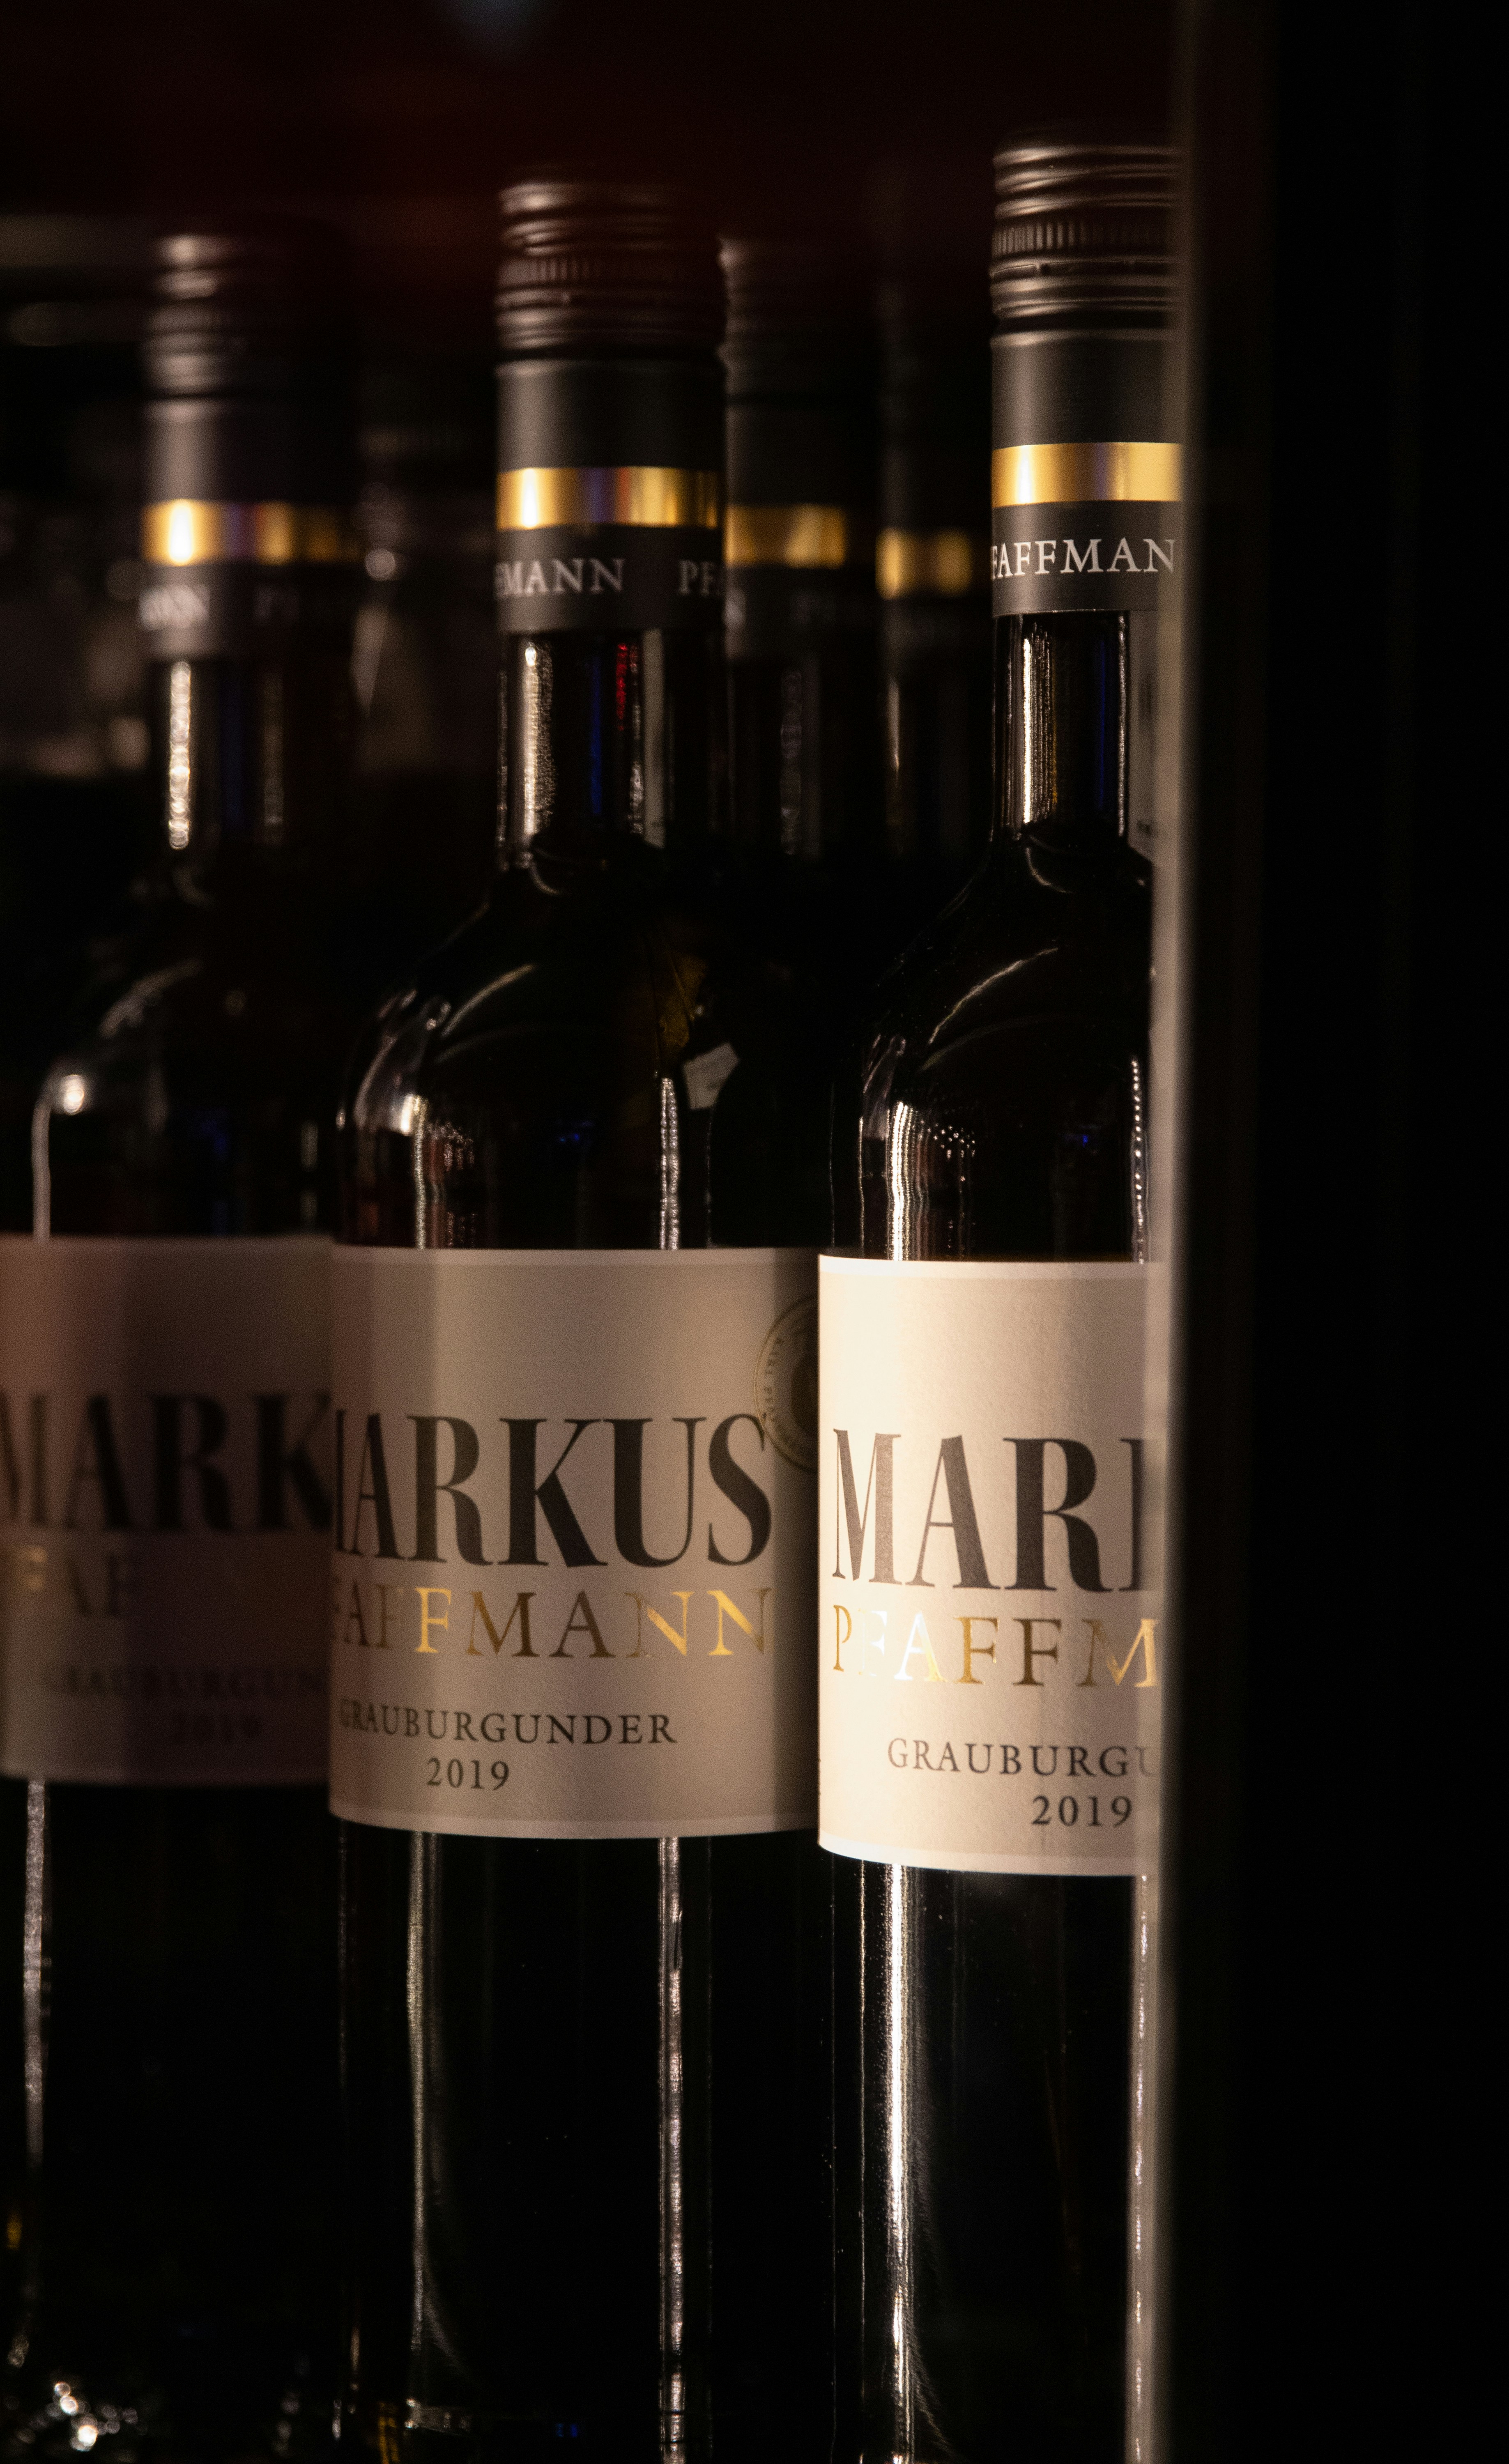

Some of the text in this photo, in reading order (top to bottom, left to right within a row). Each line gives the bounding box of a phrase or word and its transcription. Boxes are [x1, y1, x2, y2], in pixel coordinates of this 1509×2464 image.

[338, 1698, 678, 1745] GRAUBURGUNDER
[426, 1756, 510, 1791] 2019
[1031, 1795, 1133, 1827] 2019
